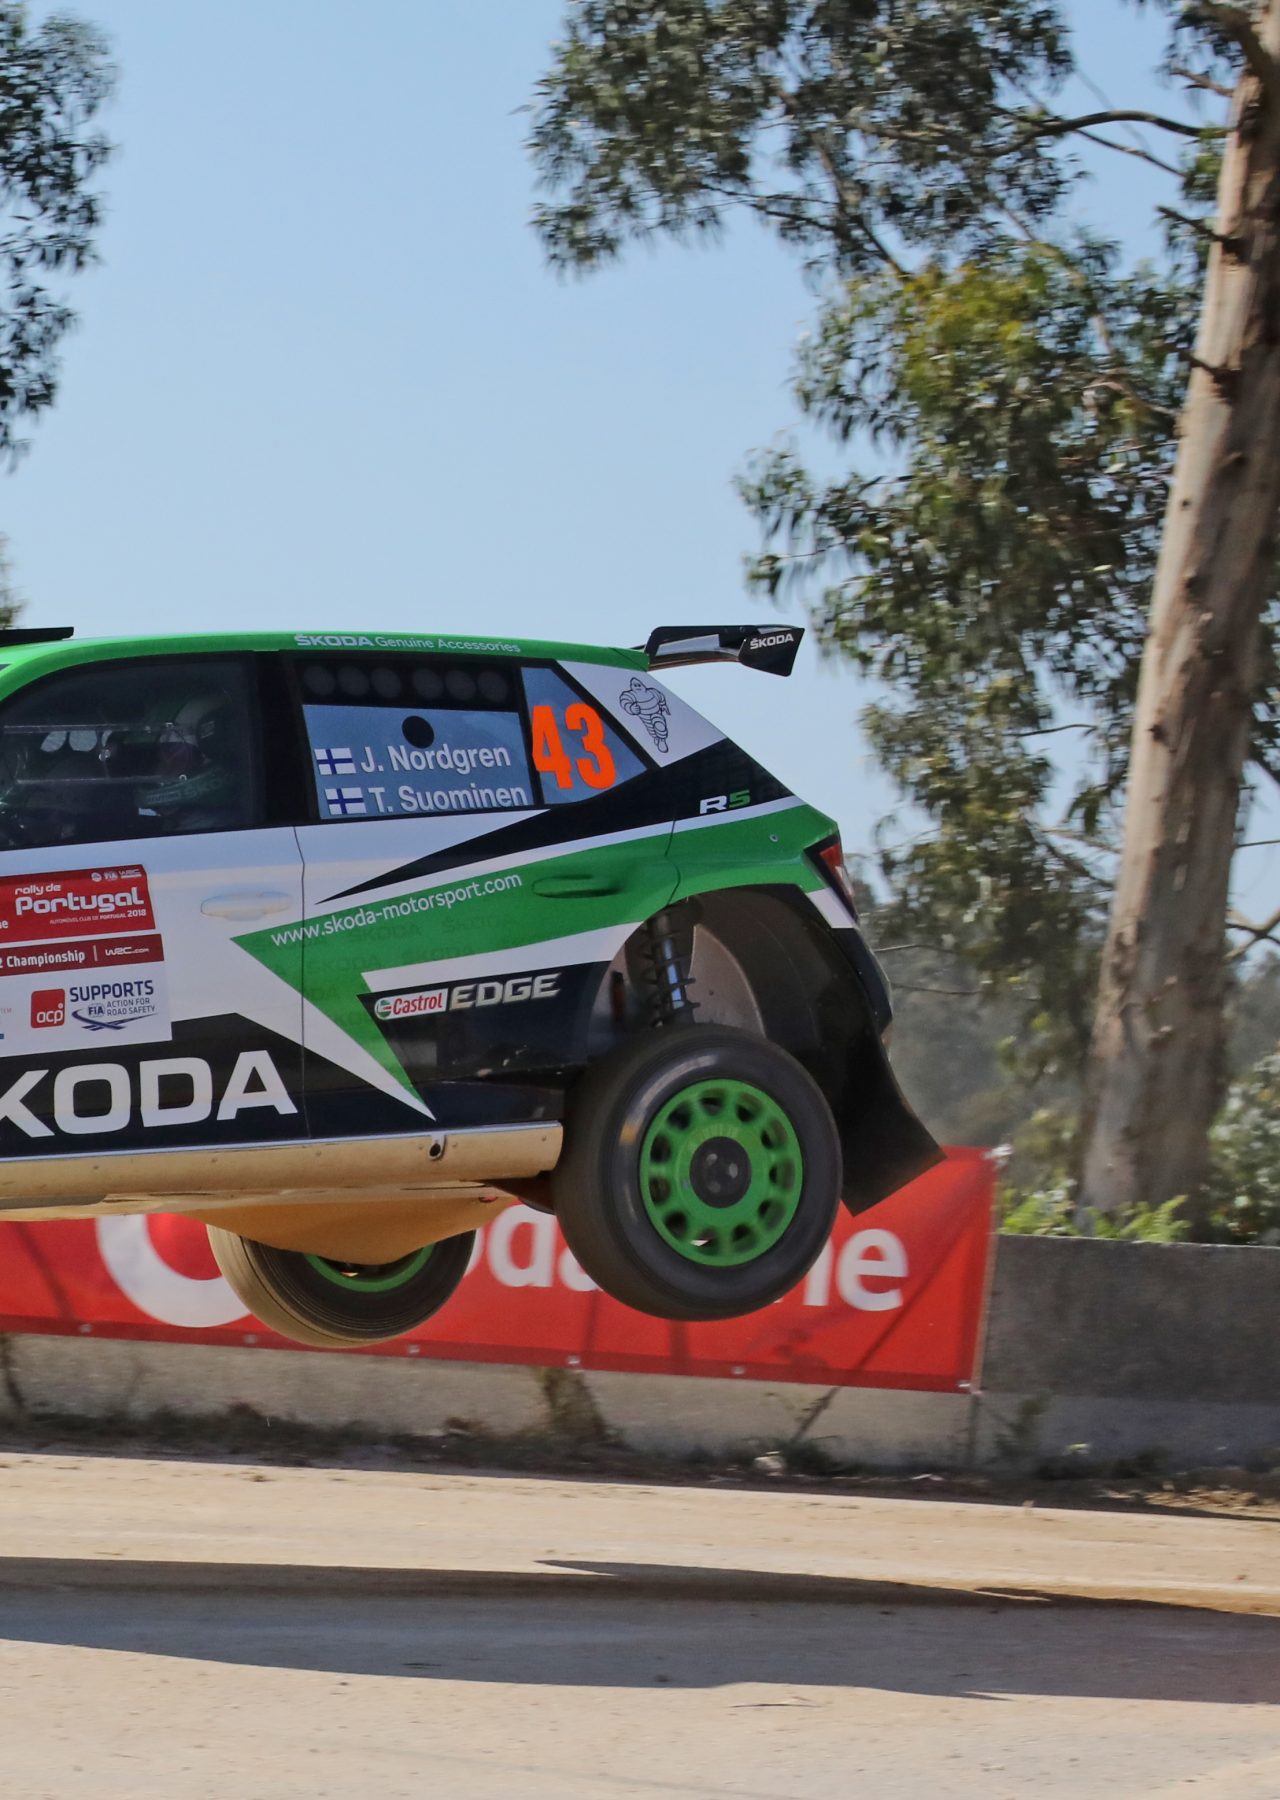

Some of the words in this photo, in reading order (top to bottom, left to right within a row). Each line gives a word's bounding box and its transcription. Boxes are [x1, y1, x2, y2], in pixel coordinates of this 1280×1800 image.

[294, 633, 373, 647] ŠKODA
[375, 636, 434, 649] Genuine
[438, 639, 520, 653] Accessories
[750, 633, 795, 650] ŠKODA
[531, 703, 617, 789] 43
[360, 746, 383, 773] J.
[392, 744, 511, 775] Nordgren
[368, 787, 393, 813] T.
[400, 783, 528, 811] Suominen
[699, 789, 751, 814] R5
[15, 884, 44, 896] rally
[45, 883, 62, 893] de
[15, 887, 145, 915] Portugal
[271, 874, 523, 946] www.skoda-motorsport.com
[127, 909, 147, 917] 2018
[6, 949, 86, 968] Championship
[69, 980, 154, 1003] SUPPORTS
[392, 992, 443, 1015] Castrol
[449, 973, 561, 1011] EDGE
[88, 1006, 105, 1016] FIA
[107, 999, 134, 1008] ACTION
[135, 997, 150, 1005] FOR
[107, 1008, 128, 1016] ROAD
[128, 1005, 156, 1015] SAFETY
[36, 1010, 64, 1024] acp
